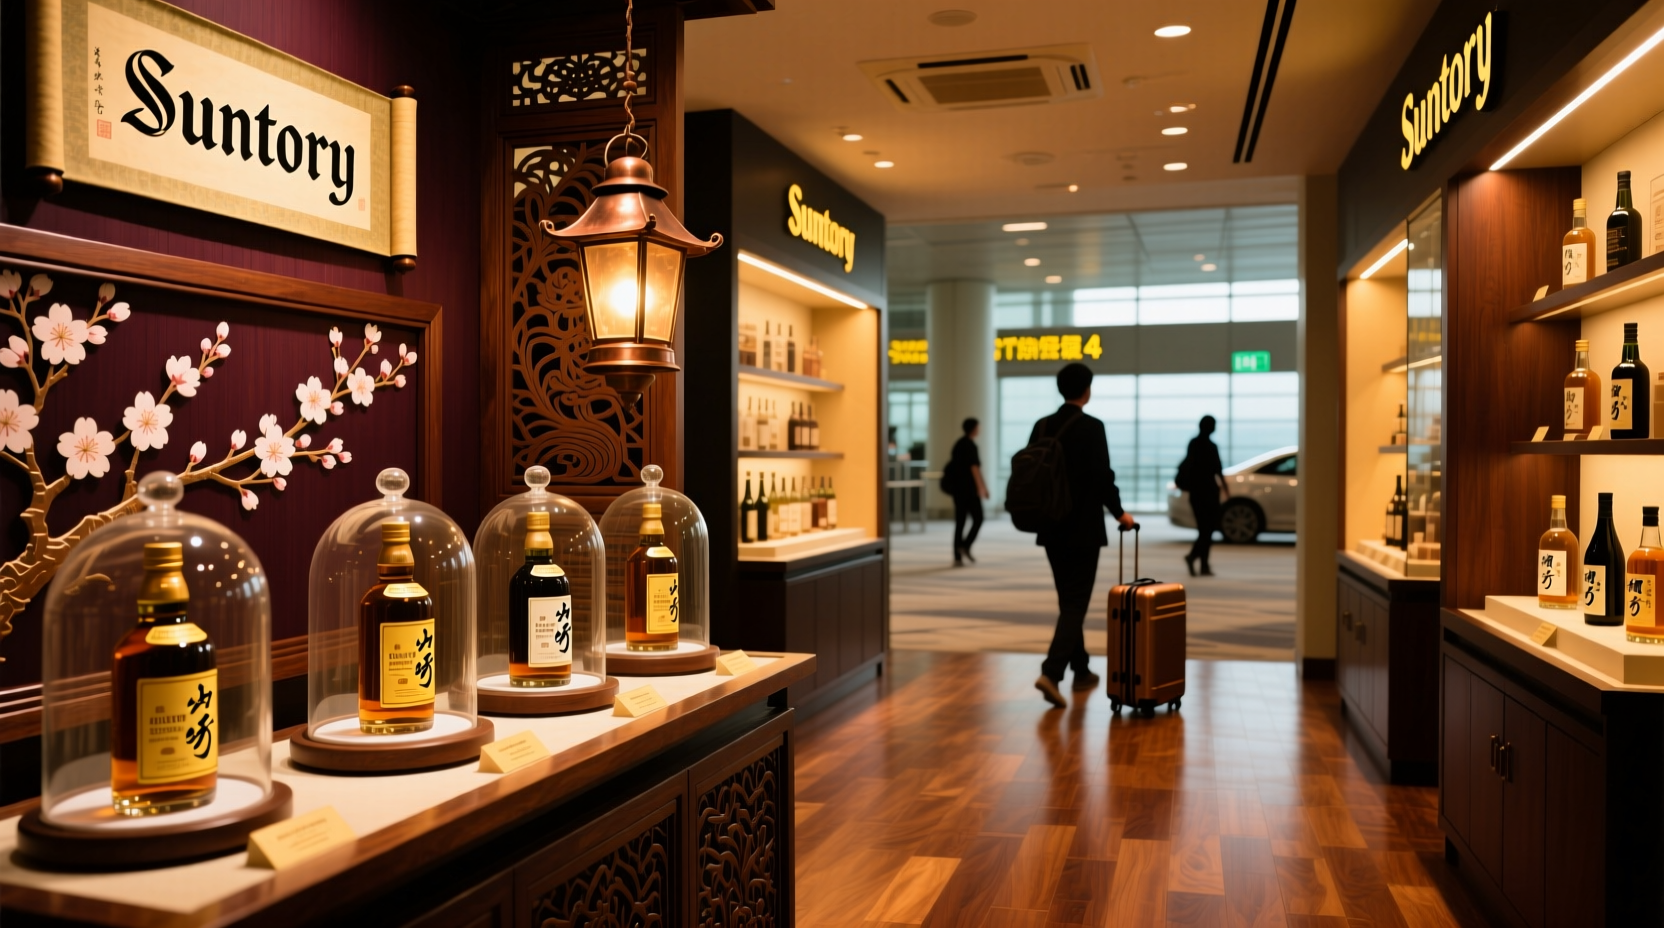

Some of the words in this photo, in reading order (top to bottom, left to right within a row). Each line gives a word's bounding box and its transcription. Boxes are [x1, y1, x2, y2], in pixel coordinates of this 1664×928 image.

[120, 49, 355, 206] Suntory
[1401, 11, 1492, 170] Suntory
[788, 183, 856, 273] Suntory
